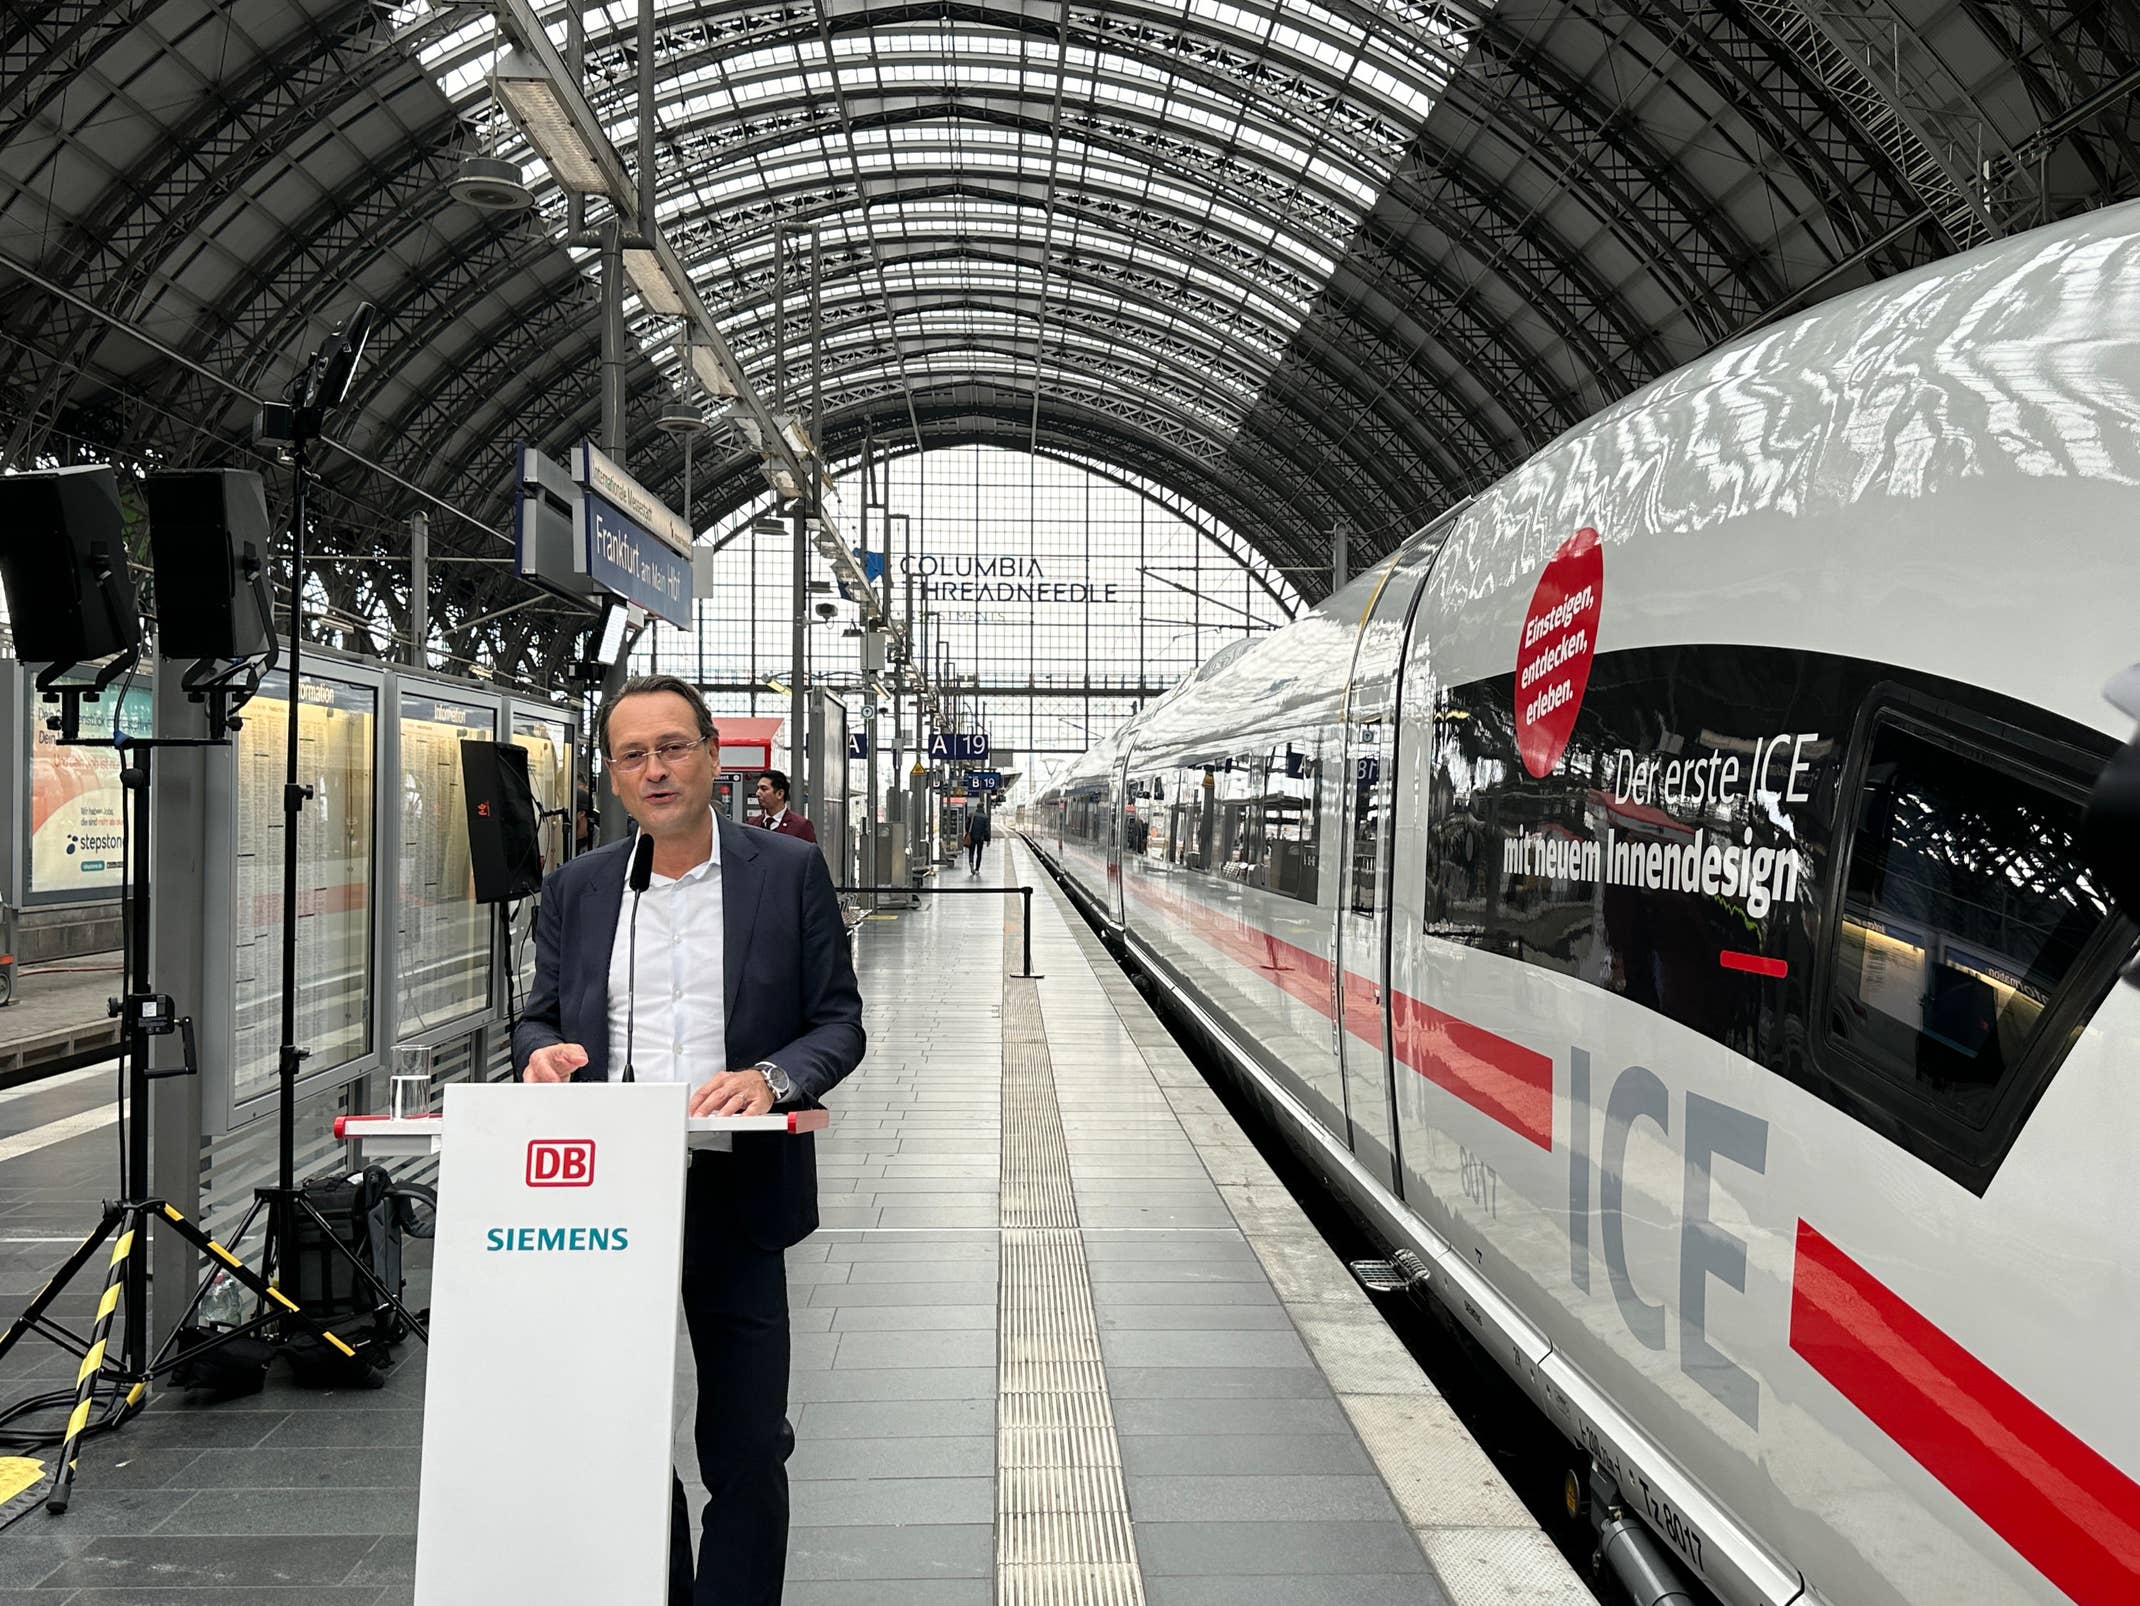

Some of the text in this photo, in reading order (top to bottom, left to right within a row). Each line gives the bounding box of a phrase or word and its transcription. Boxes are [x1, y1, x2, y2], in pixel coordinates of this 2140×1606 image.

[596, 514, 640, 579] Frankfurt
[641, 561, 652, 586] am
[652, 561, 667, 594] Main
[899, 556, 1044, 578] COLUMBIA
[1524, 585, 1594, 649] Einsteigen,
[1521, 628, 1588, 689] entdecken,
[299, 681, 336, 705] ormation
[1526, 679, 1574, 726] erleben.
[931, 735, 986, 755] A 19
[1614, 732, 1820, 806] Der erste ICE
[972, 778, 996, 789] B 19
[80, 833, 123, 854] stepston
[1503, 824, 1800, 919] mit neuem Innendesign
[535, 1147, 587, 1179] DB
[1459, 1145, 1497, 1222] 8017
[487, 1227, 629, 1252] SIEMENS
[1569, 1045, 1769, 1433] ICE
[1639, 1476, 1705, 1573] Tz 8017
